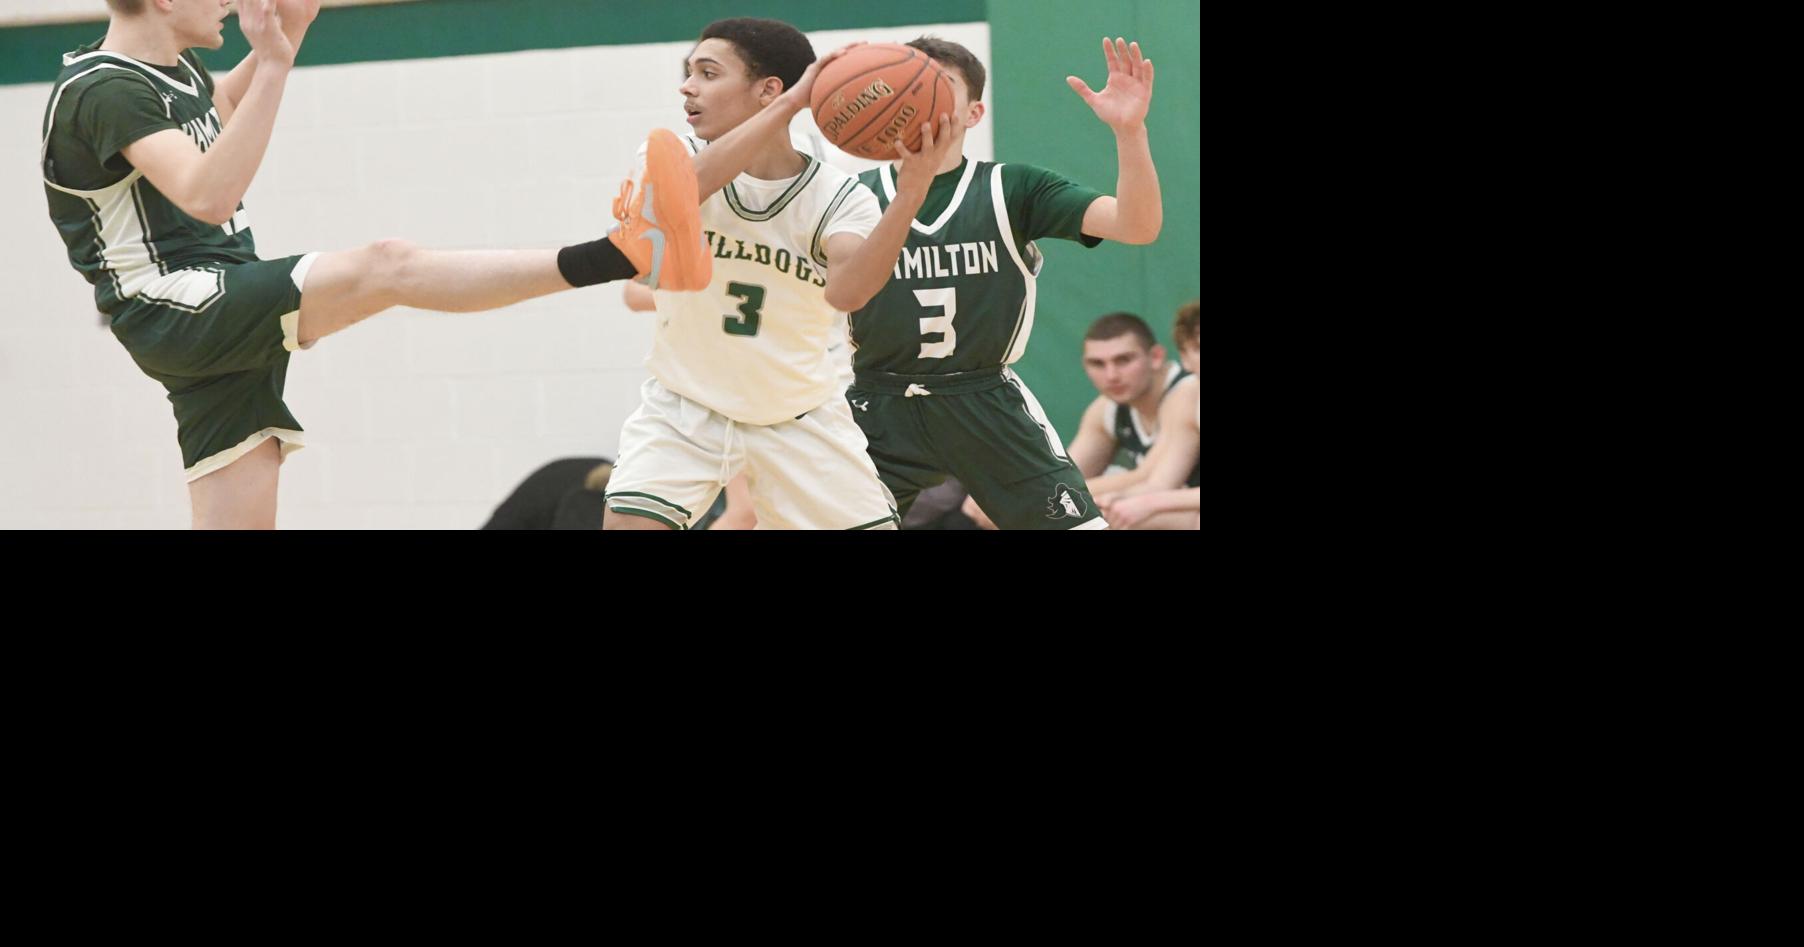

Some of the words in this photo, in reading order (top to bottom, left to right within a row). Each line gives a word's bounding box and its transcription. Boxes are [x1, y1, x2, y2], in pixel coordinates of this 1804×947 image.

[703, 230, 826, 288] LLDOGS
[722, 280, 766, 337] 3
[912, 287, 957, 359] 3
